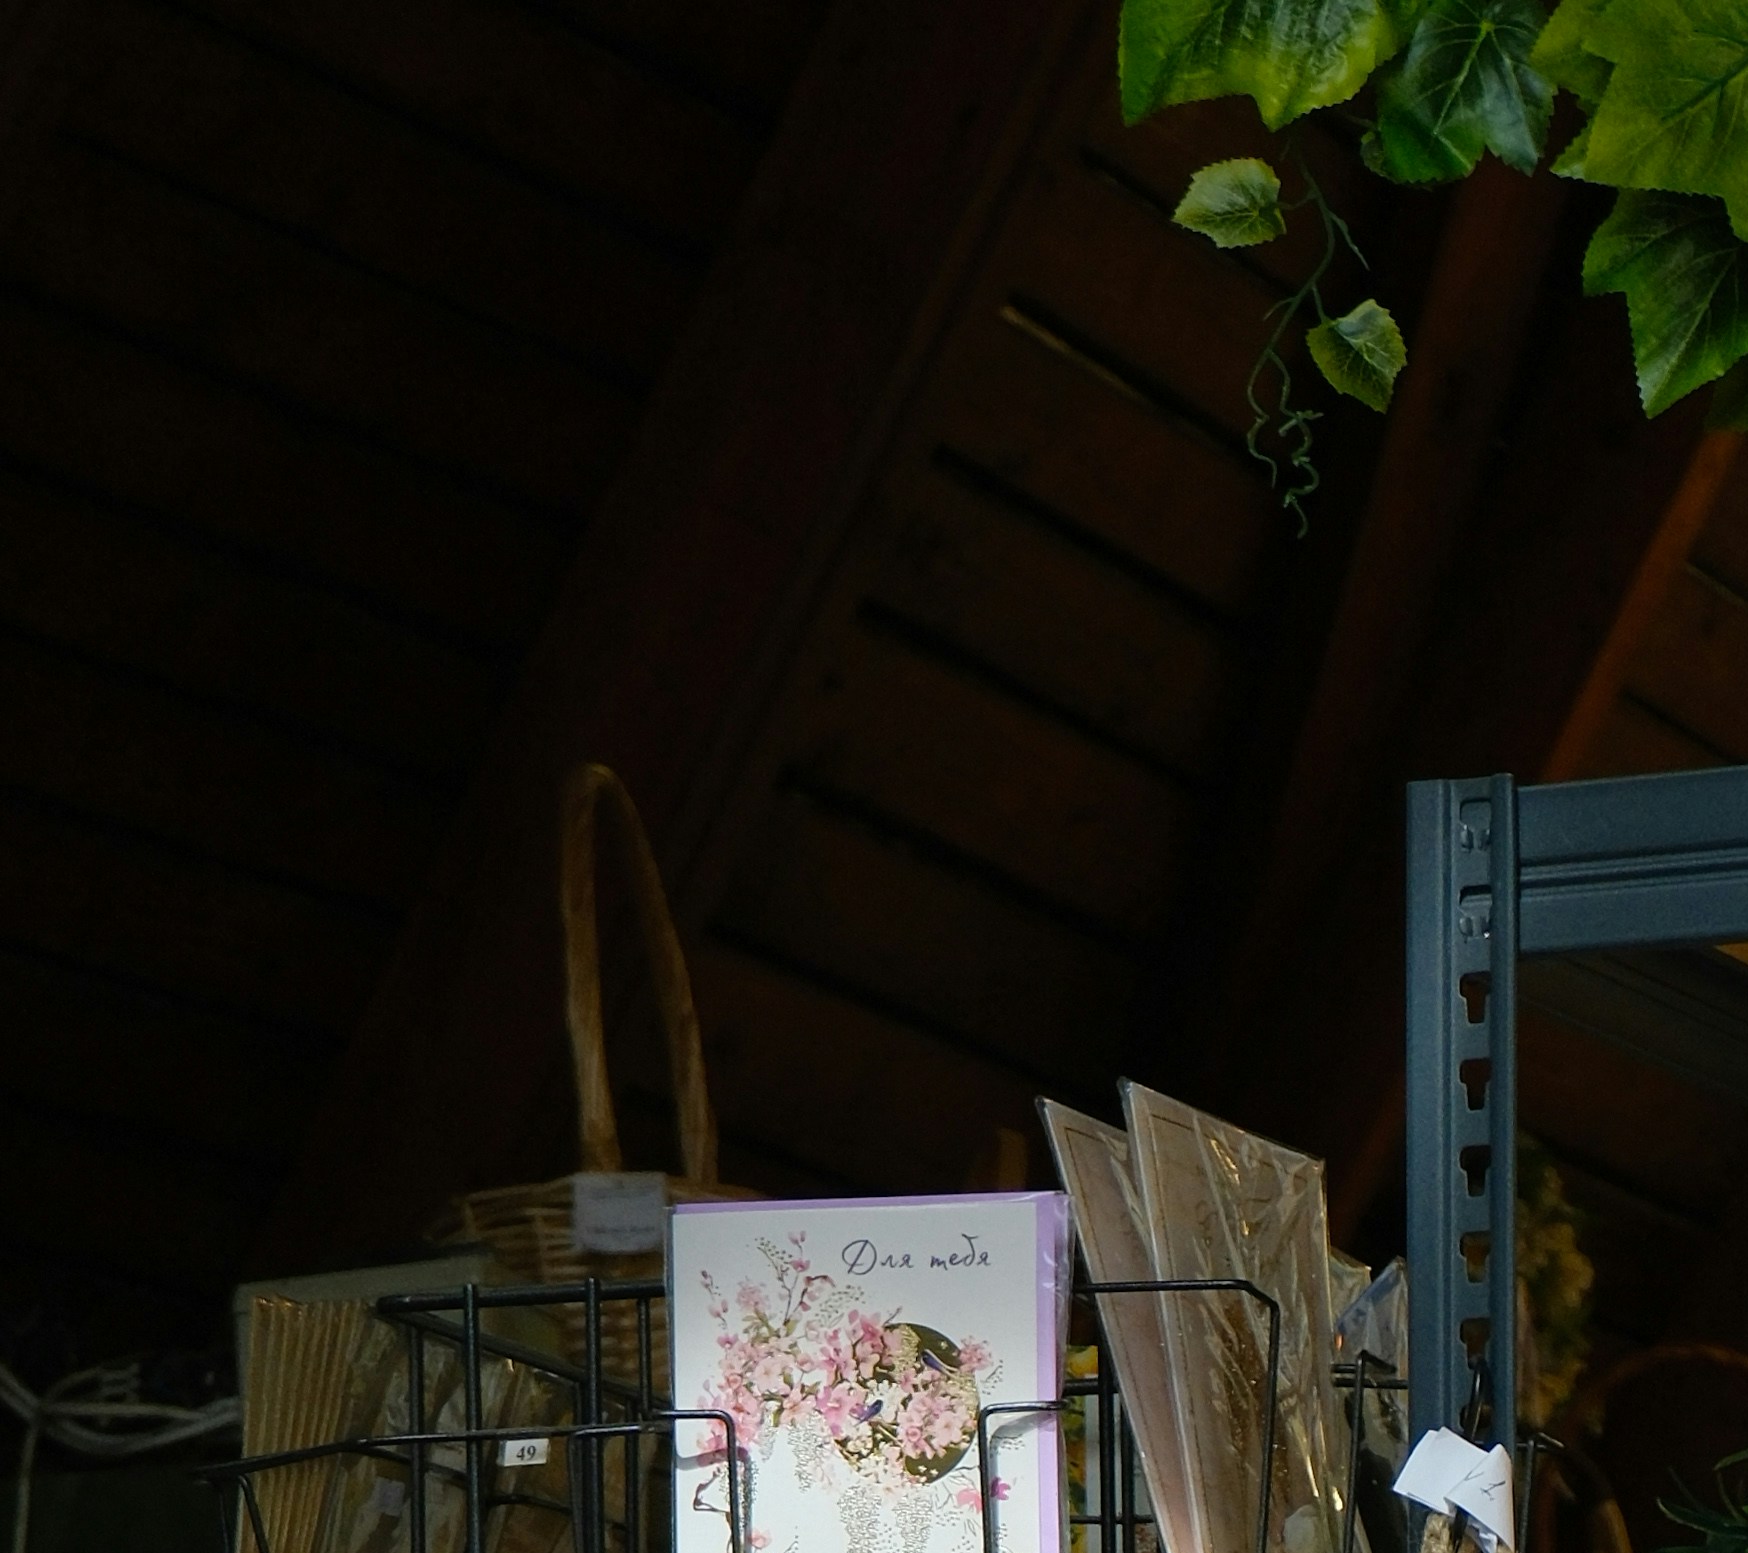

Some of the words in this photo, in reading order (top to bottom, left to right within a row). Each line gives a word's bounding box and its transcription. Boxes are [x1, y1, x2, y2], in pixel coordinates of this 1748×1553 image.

[842, 1239, 914, 1276] Для
[930, 1233, 992, 1271] тебя
[516, 1445, 537, 1461] 49
